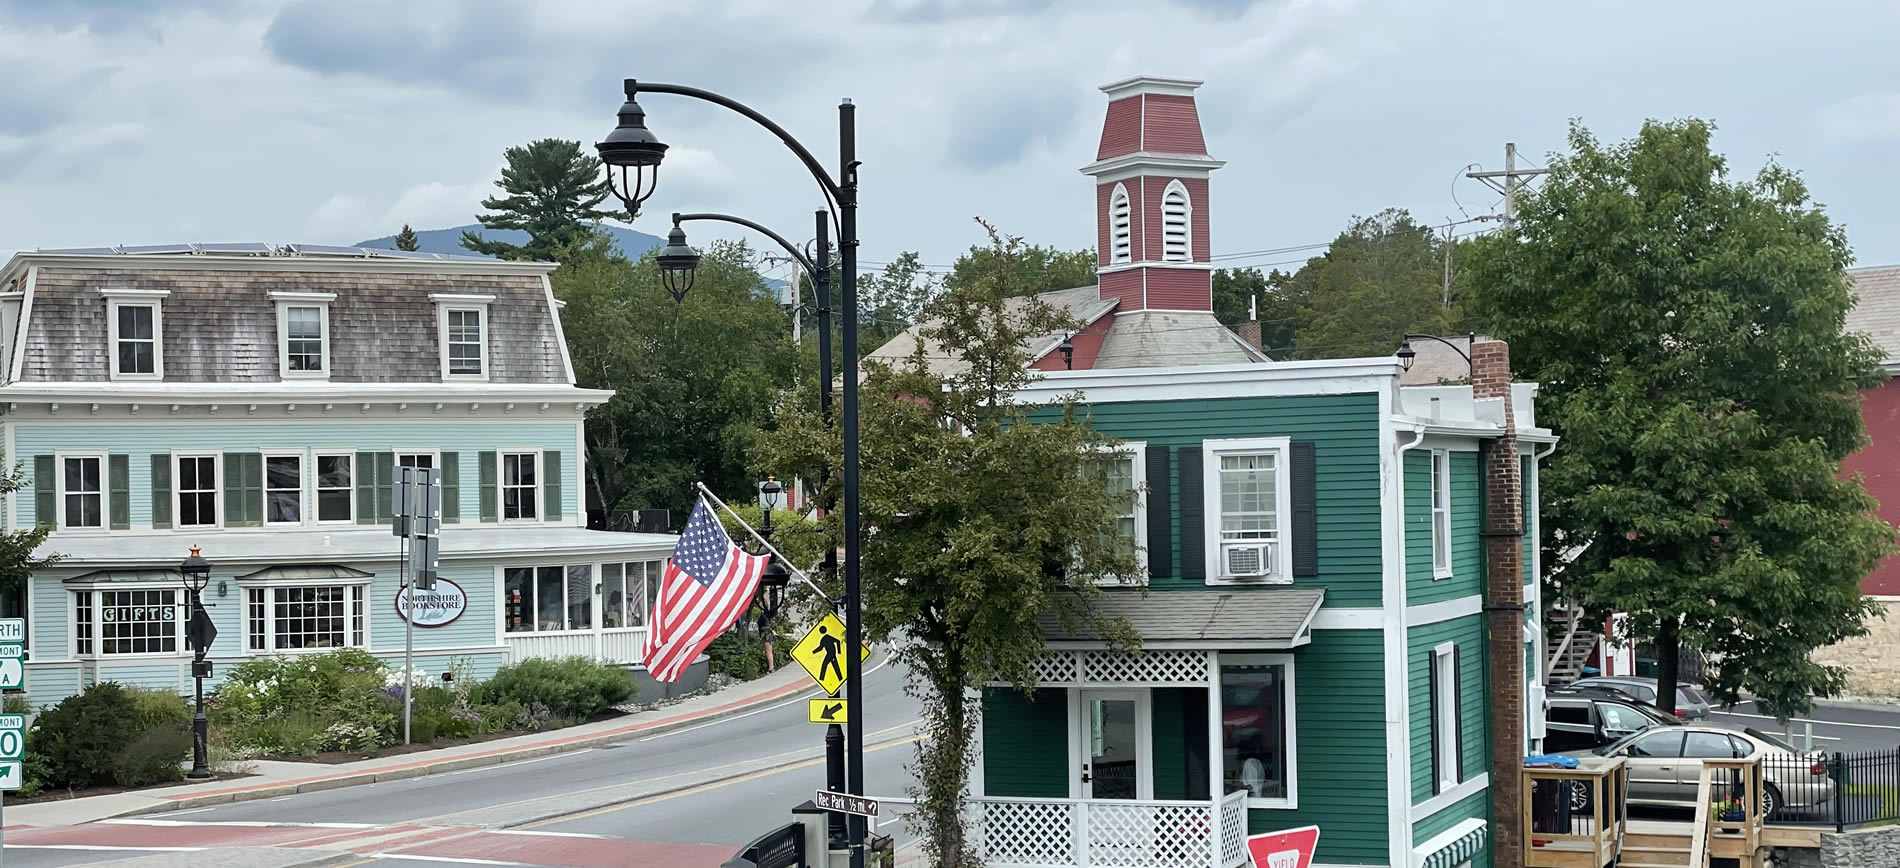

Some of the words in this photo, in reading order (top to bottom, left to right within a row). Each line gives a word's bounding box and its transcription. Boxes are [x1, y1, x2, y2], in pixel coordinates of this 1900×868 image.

[103, 607, 174, 621] GIFTS
[818, 793, 829, 807] Rec
[831, 795, 845, 809] Park
[858, 800, 866, 813] mi.
